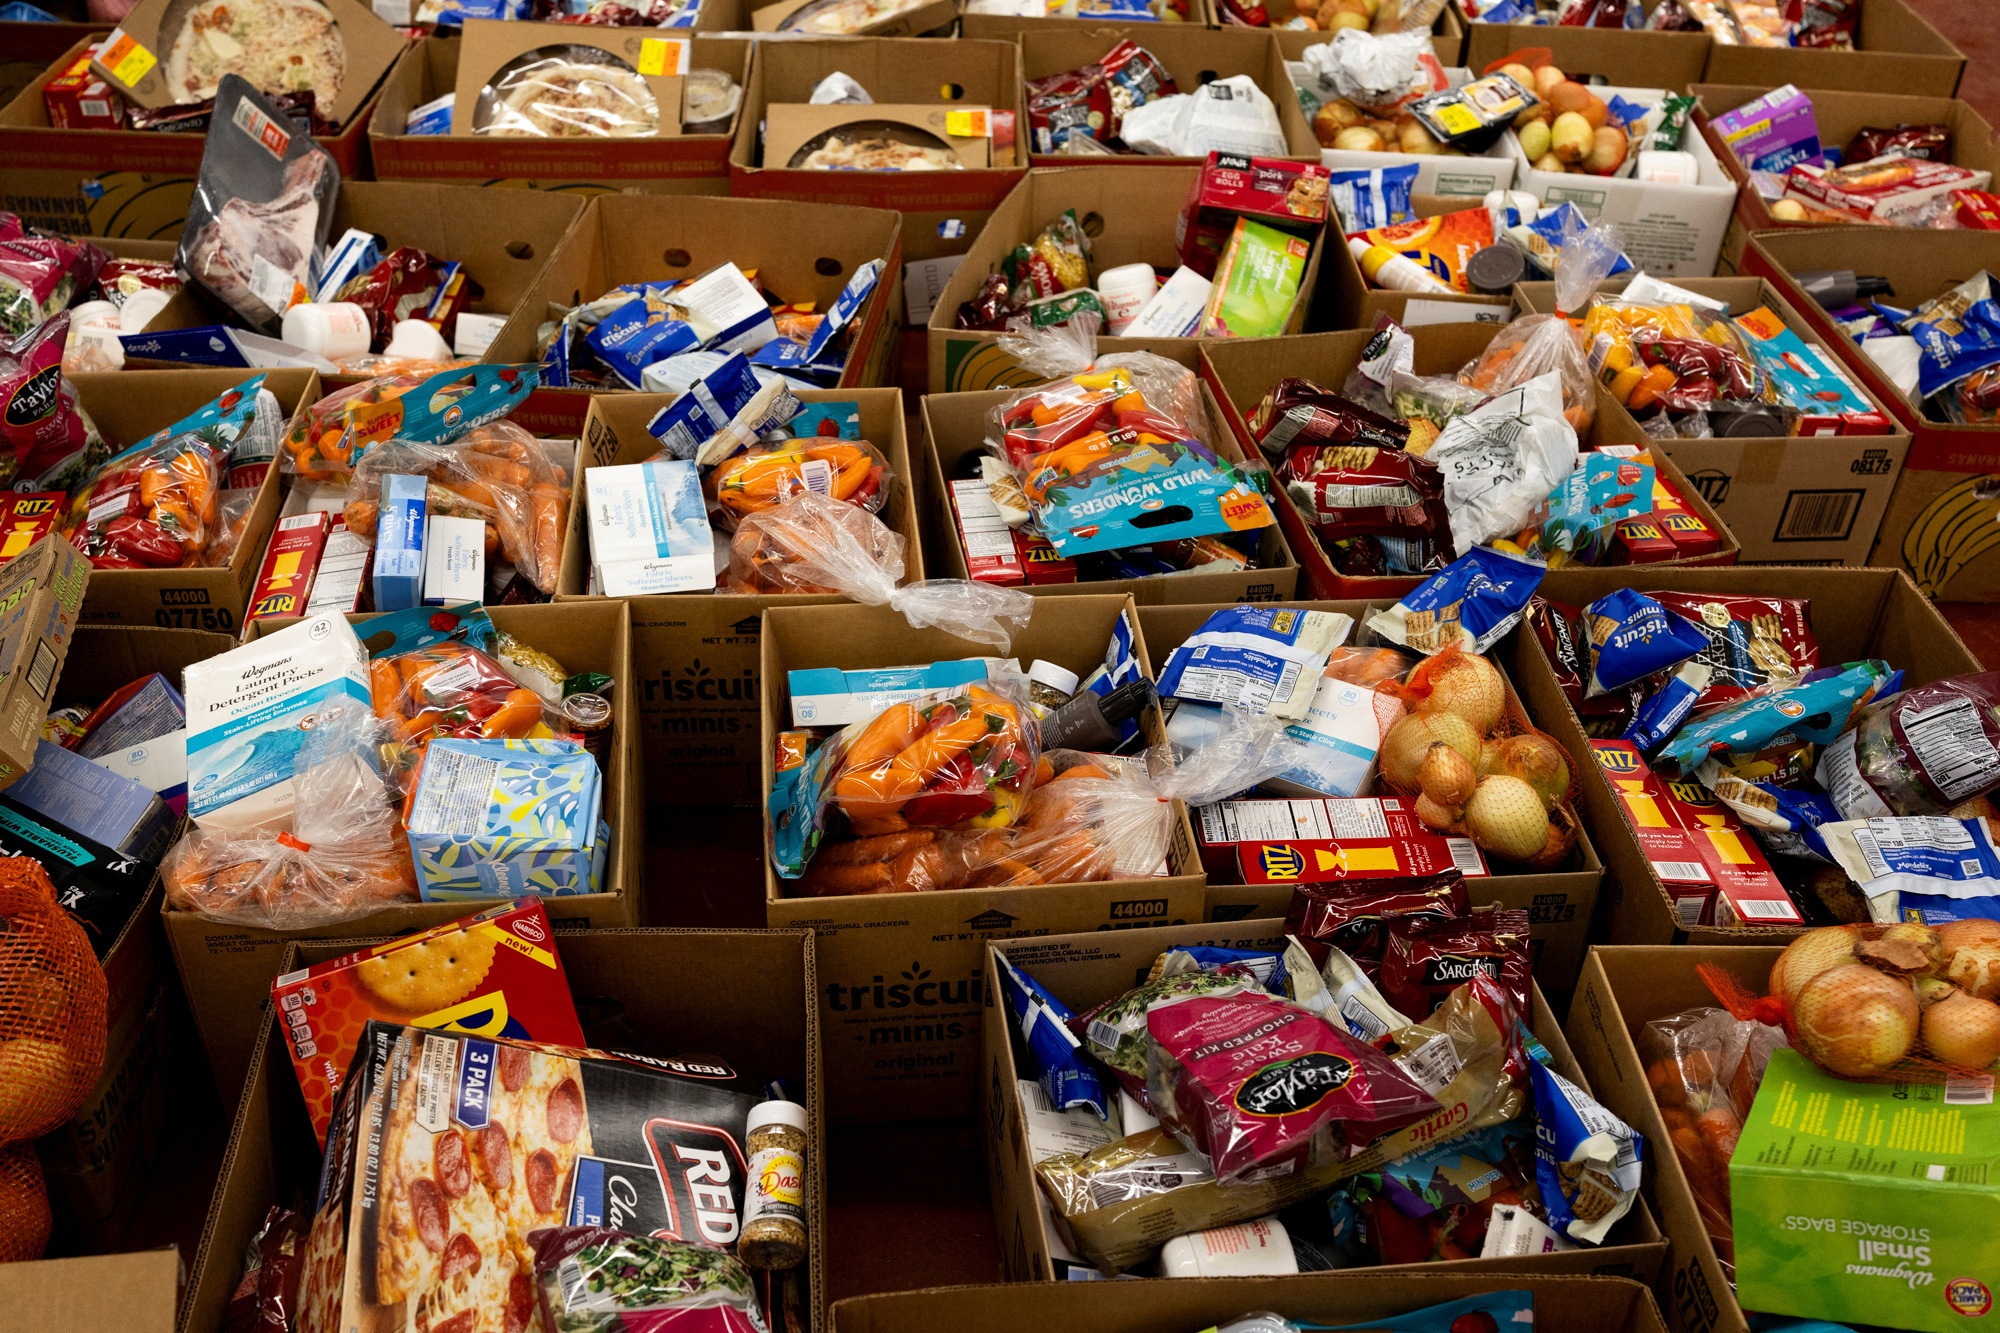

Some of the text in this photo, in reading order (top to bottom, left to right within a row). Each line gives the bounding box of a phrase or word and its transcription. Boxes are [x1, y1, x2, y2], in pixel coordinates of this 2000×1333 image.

[1215, 178, 1244, 188] ROLLS
[1221, 171, 1241, 180] EGG
[12, 370, 60, 414] Taylor
[358, 412, 401, 439] SWEET
[367, 411, 391, 426] SUPER
[1122, 431, 1138, 441] 681
[1098, 449, 1151, 470] MINI PEPPERS
[1851, 459, 1893, 474] 08175
[1069, 468, 1212, 519] WILD WONDERS
[13, 500, 55, 514] RITZ
[622, 489, 637, 539] Softener Sheets
[1225, 499, 1263, 518] SWEET
[1237, 510, 1259, 521] SUPER
[383, 505, 398, 543] Knives
[408, 507, 418, 541] Wegmans
[1618, 522, 1663, 540] RITZ
[1663, 516, 1708, 531] RITZ
[455, 535, 463, 562] Softener
[644, 562, 673, 571] Wegmans
[645, 570, 673, 578] Fabric
[627, 575, 693, 586] Softener Sheets
[1248, 585, 1272, 593] 44000
[164, 590, 205, 602] 44000
[253, 595, 297, 615] RITZ
[154, 607, 235, 630] 07750
[1626, 606, 1662, 624] minis
[313, 622, 326, 632] 42
[1554, 612, 1578, 669] SARGENTO
[1711, 629, 1727, 683] BAKES
[240, 655, 293, 680] Wegmans
[208, 666, 324, 712] Detergent Packs
[235, 666, 299, 694] Laundry
[230, 685, 302, 716] Ocean Breeze
[1344, 690, 1358, 699] 80
[223, 700, 308, 737] Stain-Lifting Enzymes
[247, 702, 285, 721] Powerful
[801, 709, 813, 718] 80
[662, 716, 741, 734] minis
[1299, 730, 1336, 747] Static Cling
[130, 749, 144, 760] 80
[669, 743, 736, 759] original
[1595, 749, 1641, 768] RITZ
[1772, 766, 1799, 780] 1.5 lb
[1935, 773, 1951, 785] 180
[1668, 782, 1719, 801] RITZ
[1205, 816, 1214, 842] Nutrition
[23, 826, 78, 863] FLUSHABLE
[1262, 844, 1298, 880] RITZ
[488, 858, 511, 898] Kleenex
[1113, 902, 1165, 916] 44000
[514, 920, 544, 940] NABISCO
[790, 918, 835, 927] CONTAINS:
[823, 920, 910, 931] ORIGINAL CRACKERS
[504, 935, 535, 955] new!
[932, 928, 1050, 943] NET WT 72 1.06 OZ
[1236, 937, 1253, 948] OZ
[1006, 945, 1058, 955] DISTRIBUTED
[1006, 952, 1050, 961] MONDELEZ
[1051, 949, 1084, 958] GLOBAL
[1026, 957, 1068, 966] HANOVER,
[1434, 960, 1498, 981] SARGENTO
[825, 970, 983, 1012] triscui
[914, 1013, 939, 1021] whole
[940, 1011, 961, 1020] grain
[1201, 1002, 1238, 1018] Dressing
[376, 1031, 388, 1047] NET
[870, 1022, 964, 1045] minis
[1194, 1014, 1295, 1060] CHOPPED KIT
[378, 1047, 387, 1062] WT.
[1231, 1034, 1286, 1061] Kale
[1231, 1039, 1304, 1072] Sweet
[423, 1053, 431, 1075] SOURCE
[446, 1054, 455, 1071] REAL
[611, 1050, 728, 1075] RED BARON
[875, 1052, 955, 1071] original
[1262, 1058, 1312, 1082] FARMS
[324, 1060, 338, 1084] with
[374, 1063, 385, 1086] 61.80
[464, 1052, 489, 1110] 3 PACK
[429, 1040, 445, 1125] EXCELLENT SOURCE PROTEIN
[441, 1074, 451, 1094] CHEESE
[1250, 1065, 1342, 1113] Taylor
[372, 1085, 384, 1100] OZ.
[419, 1085, 427, 1108] CALCIUM
[370, 1112, 382, 1129] LBS.
[1408, 1101, 1469, 1143] Garlic
[368, 1131, 381, 1156] 13.80
[364, 1156, 379, 1174] OZ.)
[363, 1178, 377, 1197] 1.75
[760, 1171, 804, 1196] Dash
[1467, 1175, 1485, 1193] MINI
[360, 1197, 375, 1209] kg
[675, 1144, 740, 1244] RED
[1785, 1215, 1930, 1243] STORAGE BAGS
[1858, 1239, 1932, 1267] Small
[1845, 1260, 1936, 1290] Wegmans
[1950, 1285, 1982, 1295] PACK
[1951, 1294, 1989, 1304] FAMILY
